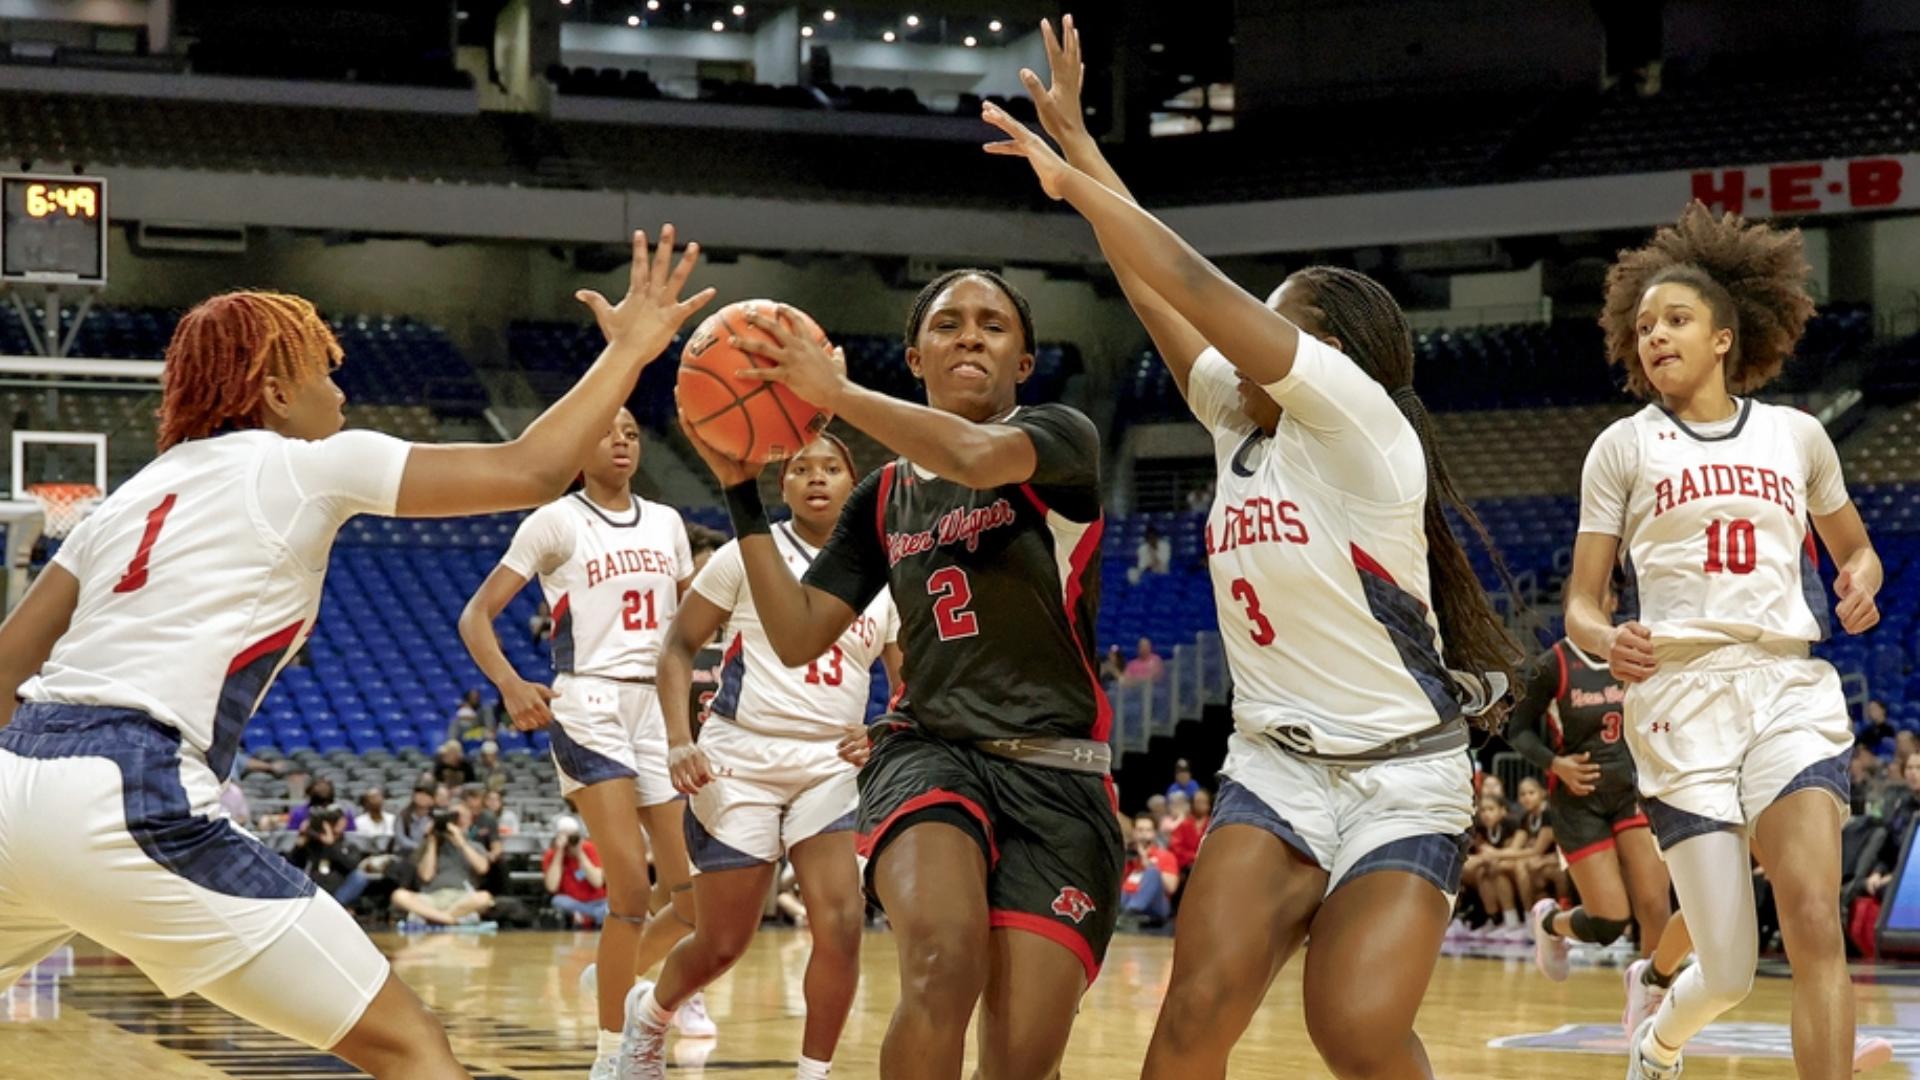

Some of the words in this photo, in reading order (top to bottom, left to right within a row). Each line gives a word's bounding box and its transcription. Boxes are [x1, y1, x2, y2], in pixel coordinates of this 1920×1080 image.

[26, 184, 95, 217] 6:49
[1654, 464, 1795, 517] RAIDERS
[112, 493, 178, 593] 1
[1703, 518, 1756, 575] 10
[622, 588, 658, 631] 21
[926, 565, 979, 641] 2
[1231, 577, 1276, 647] 3
[804, 643, 843, 686] 13
[1601, 711, 1622, 744] 3
